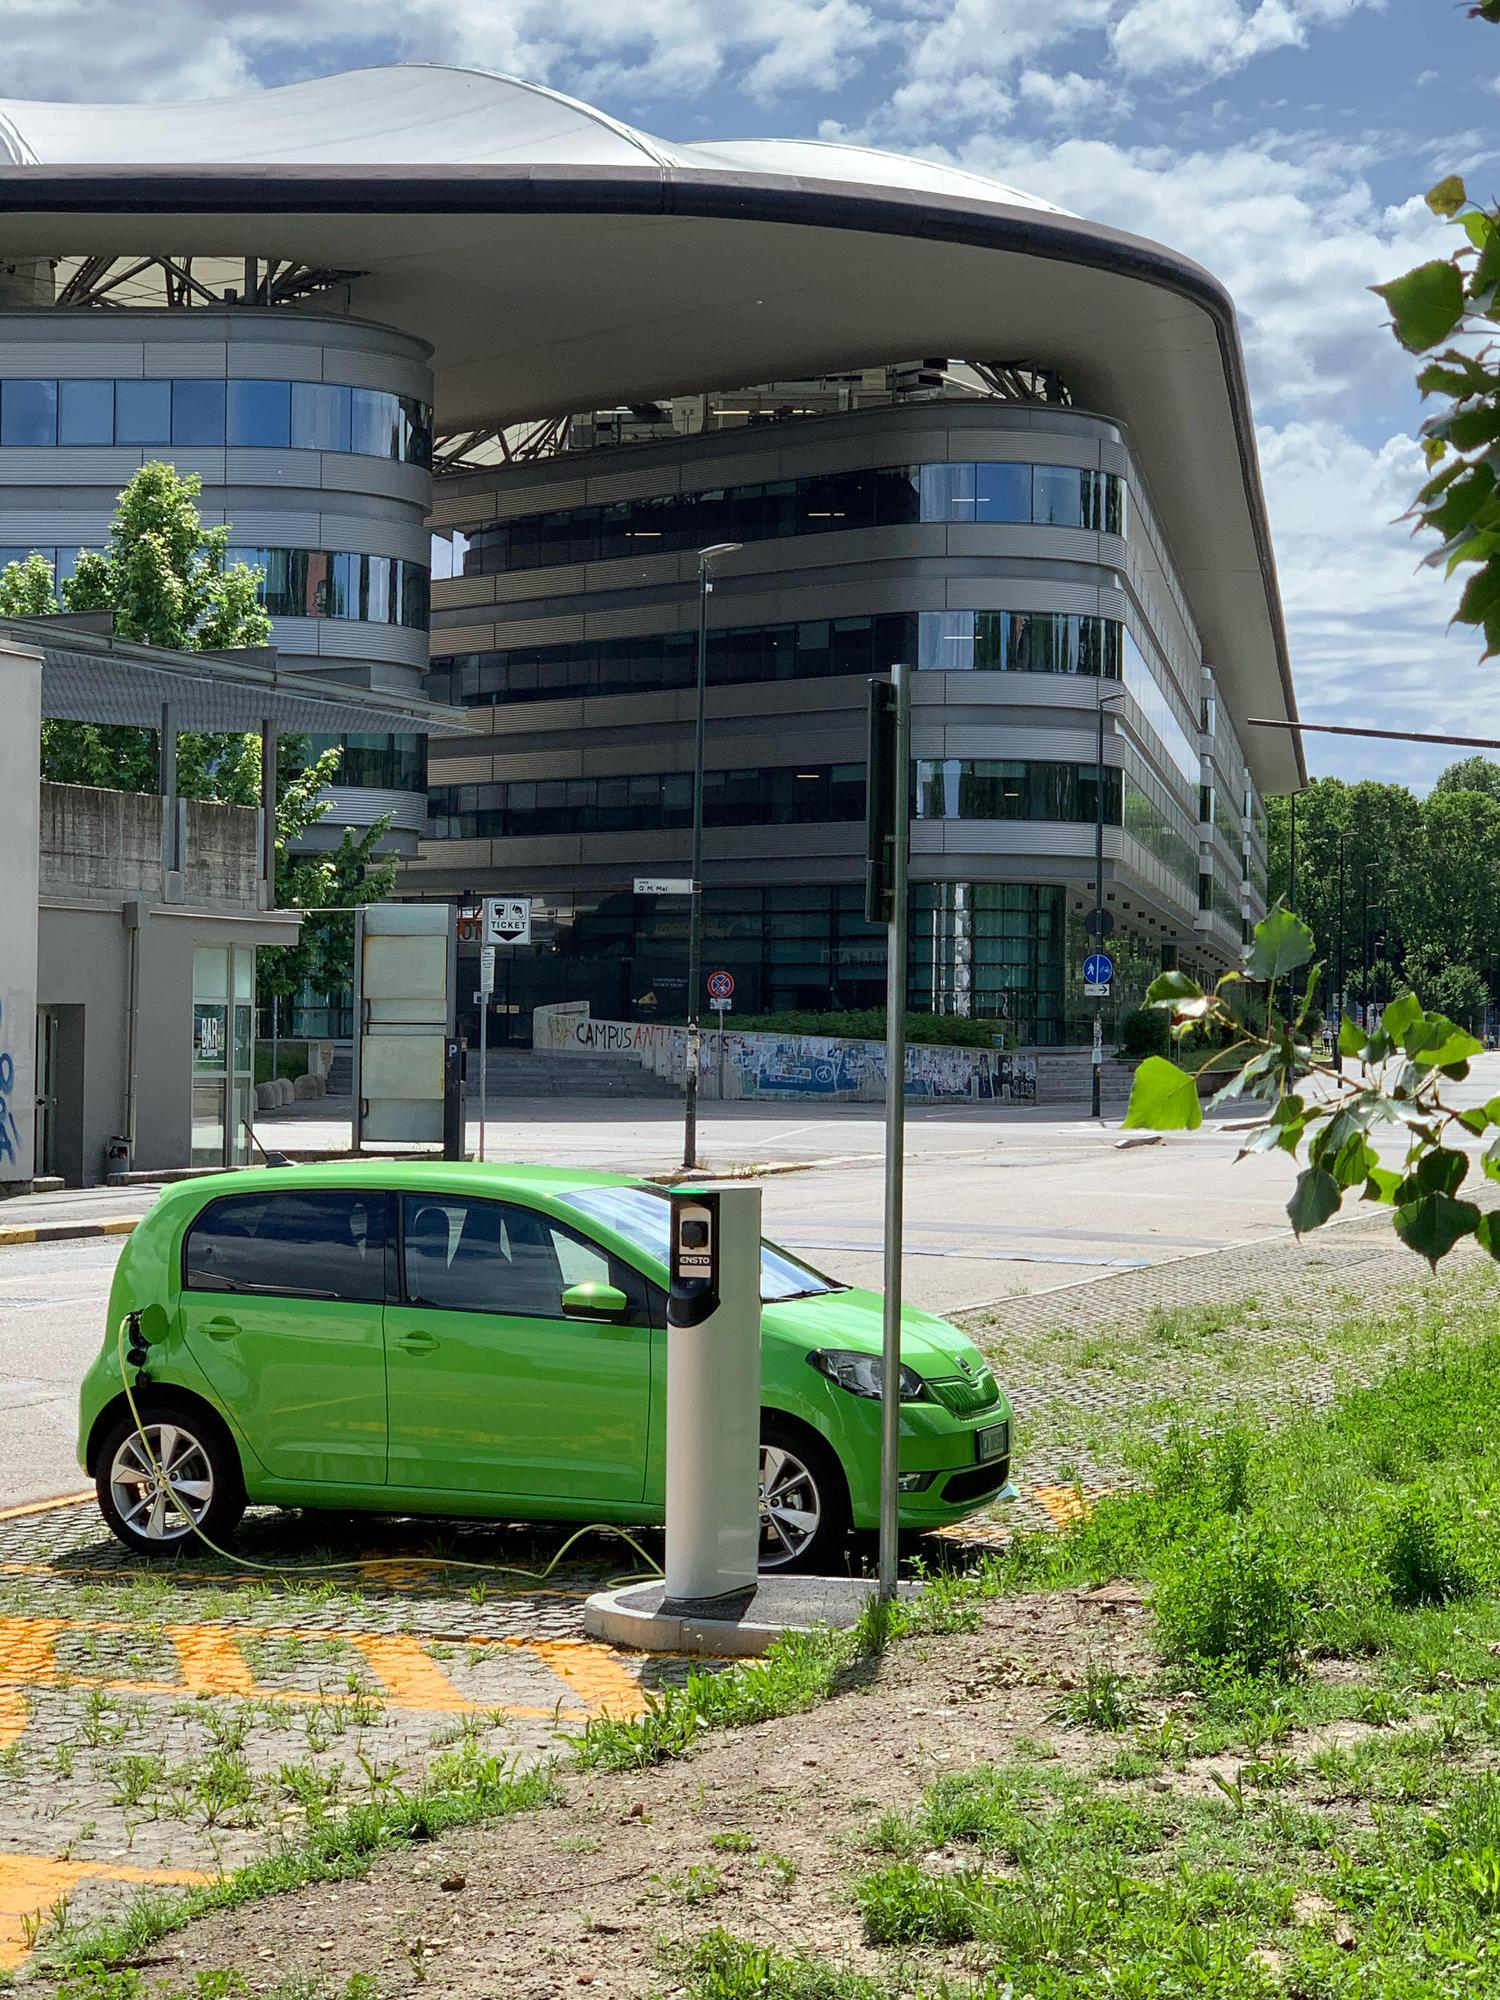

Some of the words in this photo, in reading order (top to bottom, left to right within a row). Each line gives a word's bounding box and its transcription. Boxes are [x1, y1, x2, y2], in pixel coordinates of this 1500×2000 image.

[490, 921, 527, 929] TICKET
[201, 1017, 218, 1048] BAR
[576, 1023, 633, 1049] CAMPUS
[448, 1044, 458, 1057] P
[679, 1256, 710, 1265] ENSTO
